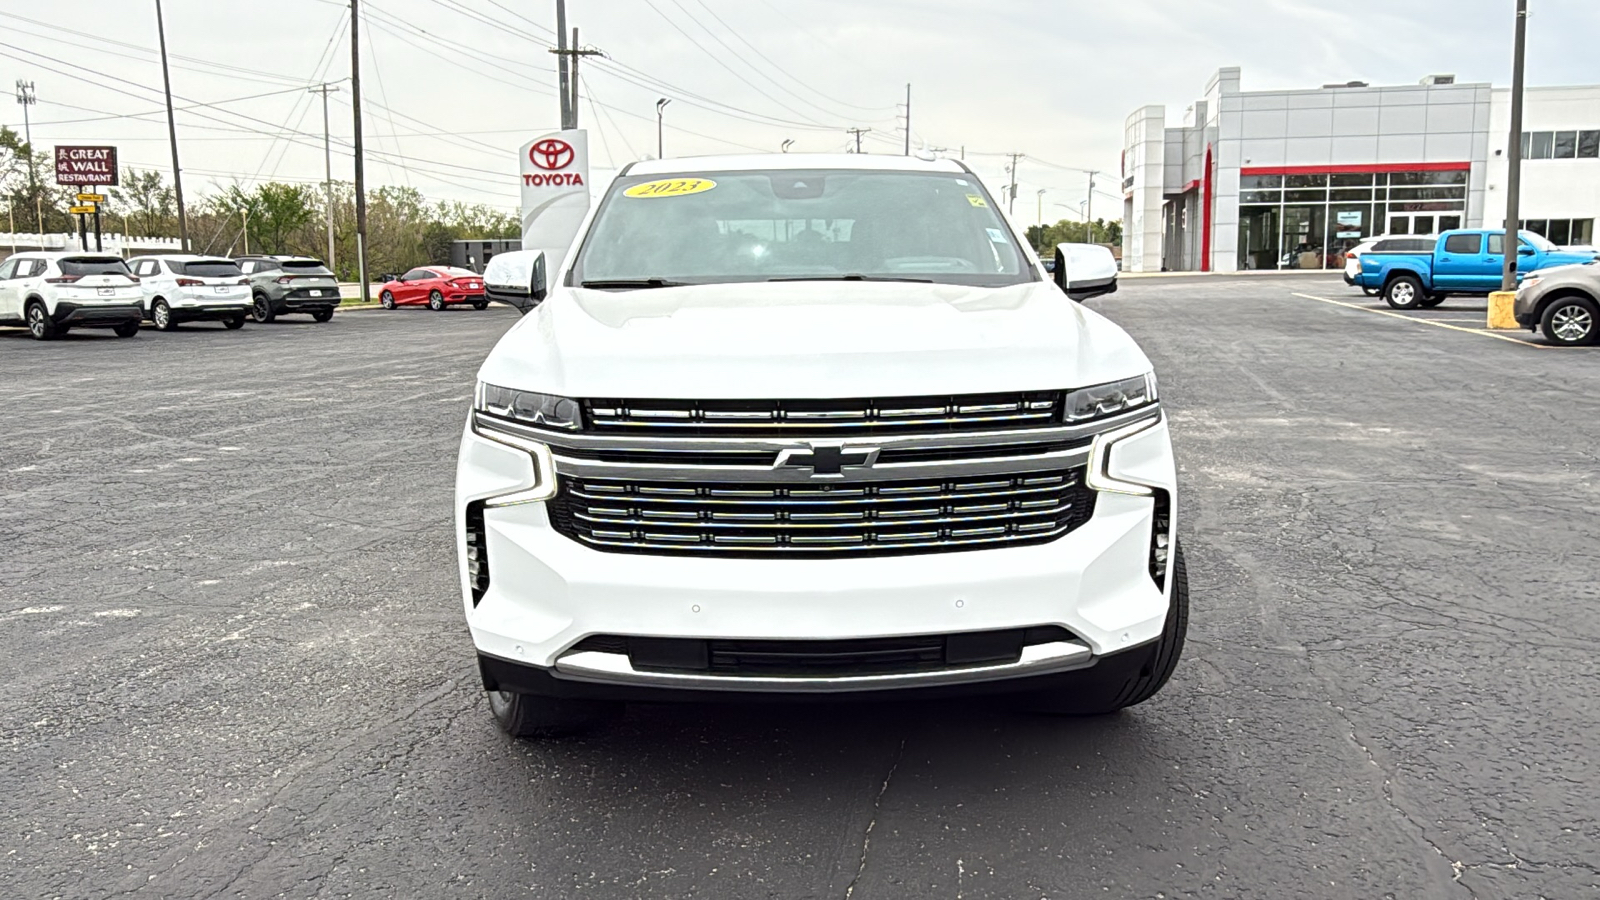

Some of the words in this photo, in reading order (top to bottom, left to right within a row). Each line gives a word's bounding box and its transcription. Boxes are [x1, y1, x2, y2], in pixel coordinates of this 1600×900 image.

[70, 149, 110, 160] GREAT
[70, 161, 109, 172] WALL
[58, 174, 112, 182] RESTAURANT
[522, 173, 584, 187] TOYOTA
[638, 181, 702, 195] 2023
